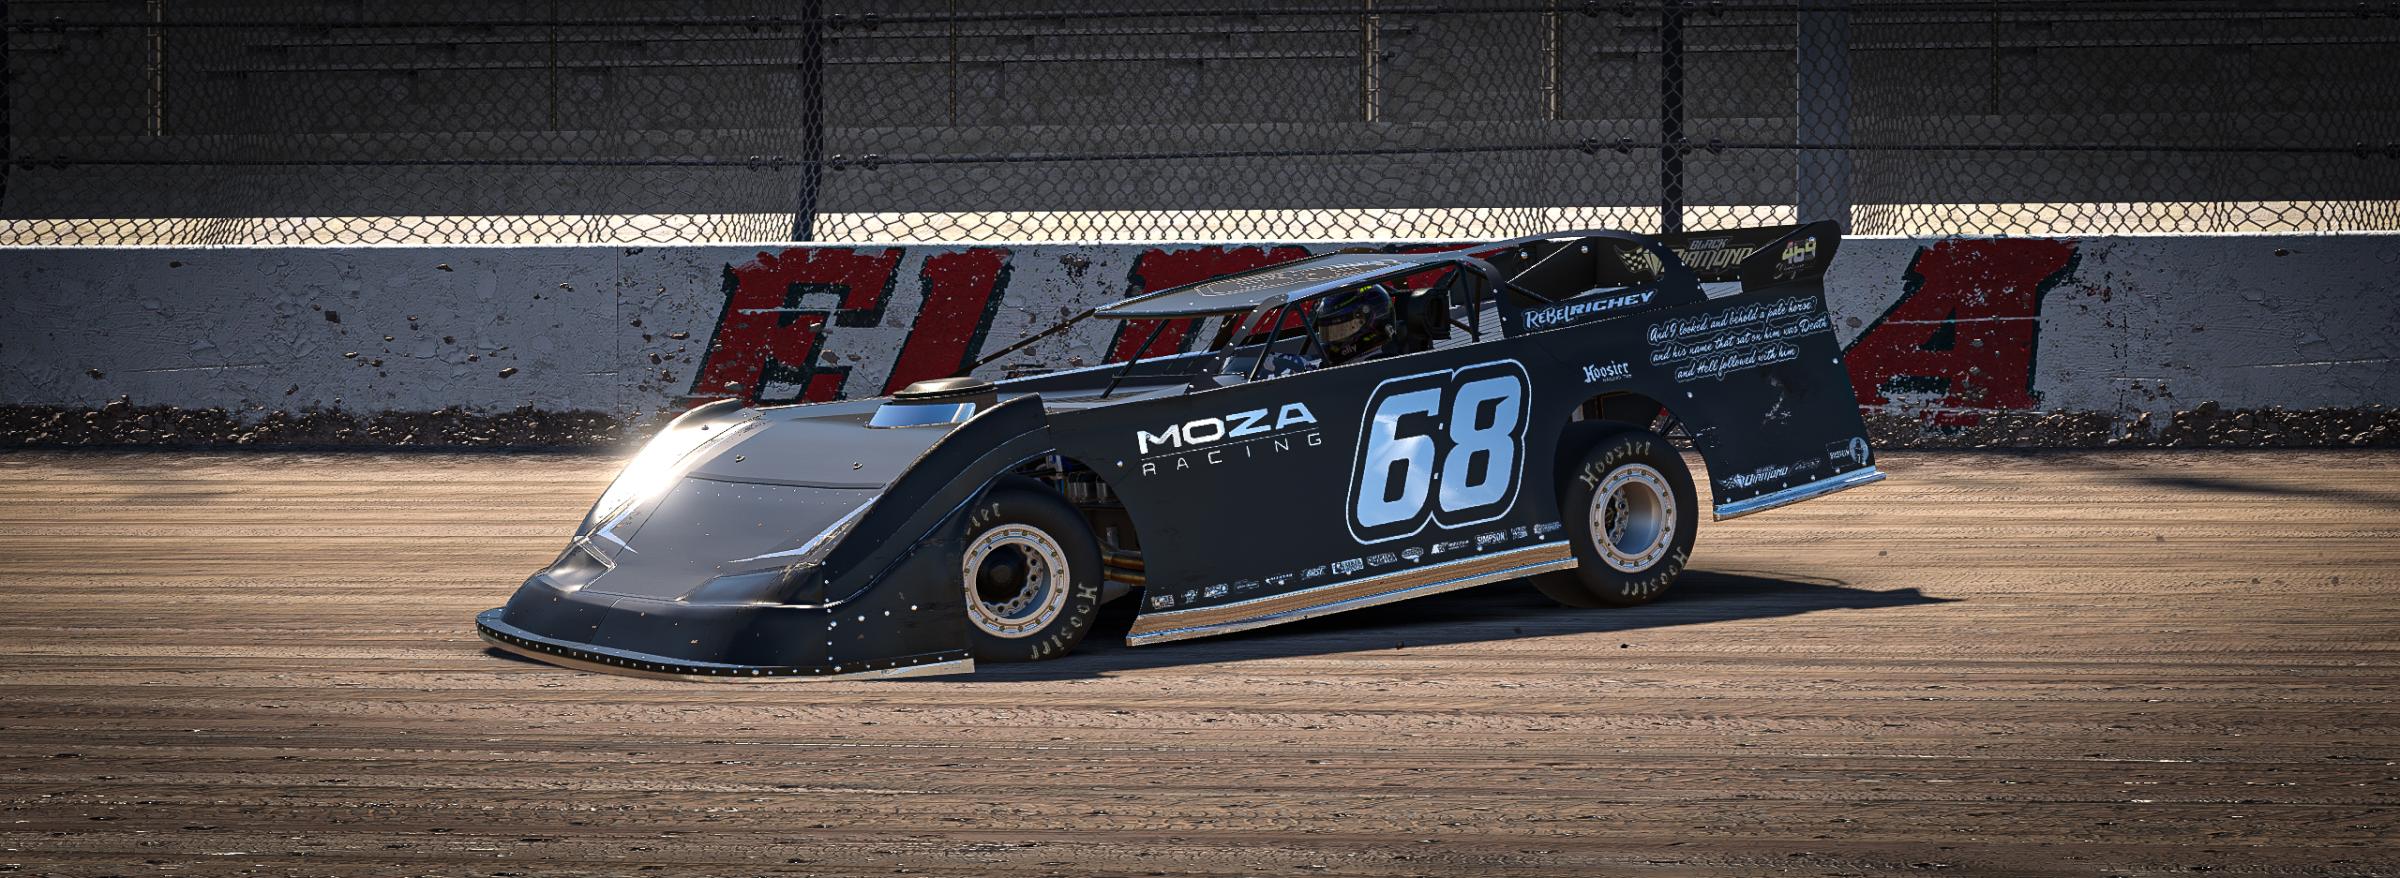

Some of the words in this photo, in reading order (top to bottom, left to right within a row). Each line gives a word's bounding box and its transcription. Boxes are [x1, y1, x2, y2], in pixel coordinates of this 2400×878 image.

[1689, 238, 1728, 251] BLACK
[1650, 325, 1669, 342] And
[1710, 313, 1728, 328] and
[1729, 307, 1758, 325] behold
[1759, 311, 1765, 319] a
[1765, 303, 1786, 324] pale
[1653, 346, 1671, 361] and
[1673, 345, 1686, 357] his
[1689, 343, 1712, 354] name
[1713, 336, 1735, 349] that
[1736, 332, 1751, 345] sat
[1751, 334, 1762, 343] on
[1763, 326, 1781, 339] him
[1782, 326, 1798, 336] was
[1583, 360, 1628, 383] Hoosier
[1678, 362, 1695, 378] and
[1697, 359, 1718, 373] Hell
[1718, 350, 1757, 377] followed
[1757, 347, 1777, 361] with
[1778, 345, 1795, 358] him
[1137, 402, 1318, 455] MOZA
[1142, 432, 1321, 477] RACING
[1357, 375, 1521, 528] 68
[1579, 438, 1651, 491] Hoosier
[1476, 531, 1506, 547] SIMPSON
[1620, 546, 1687, 599] Hoosier
[1031, 582, 1098, 661] Hoosier
